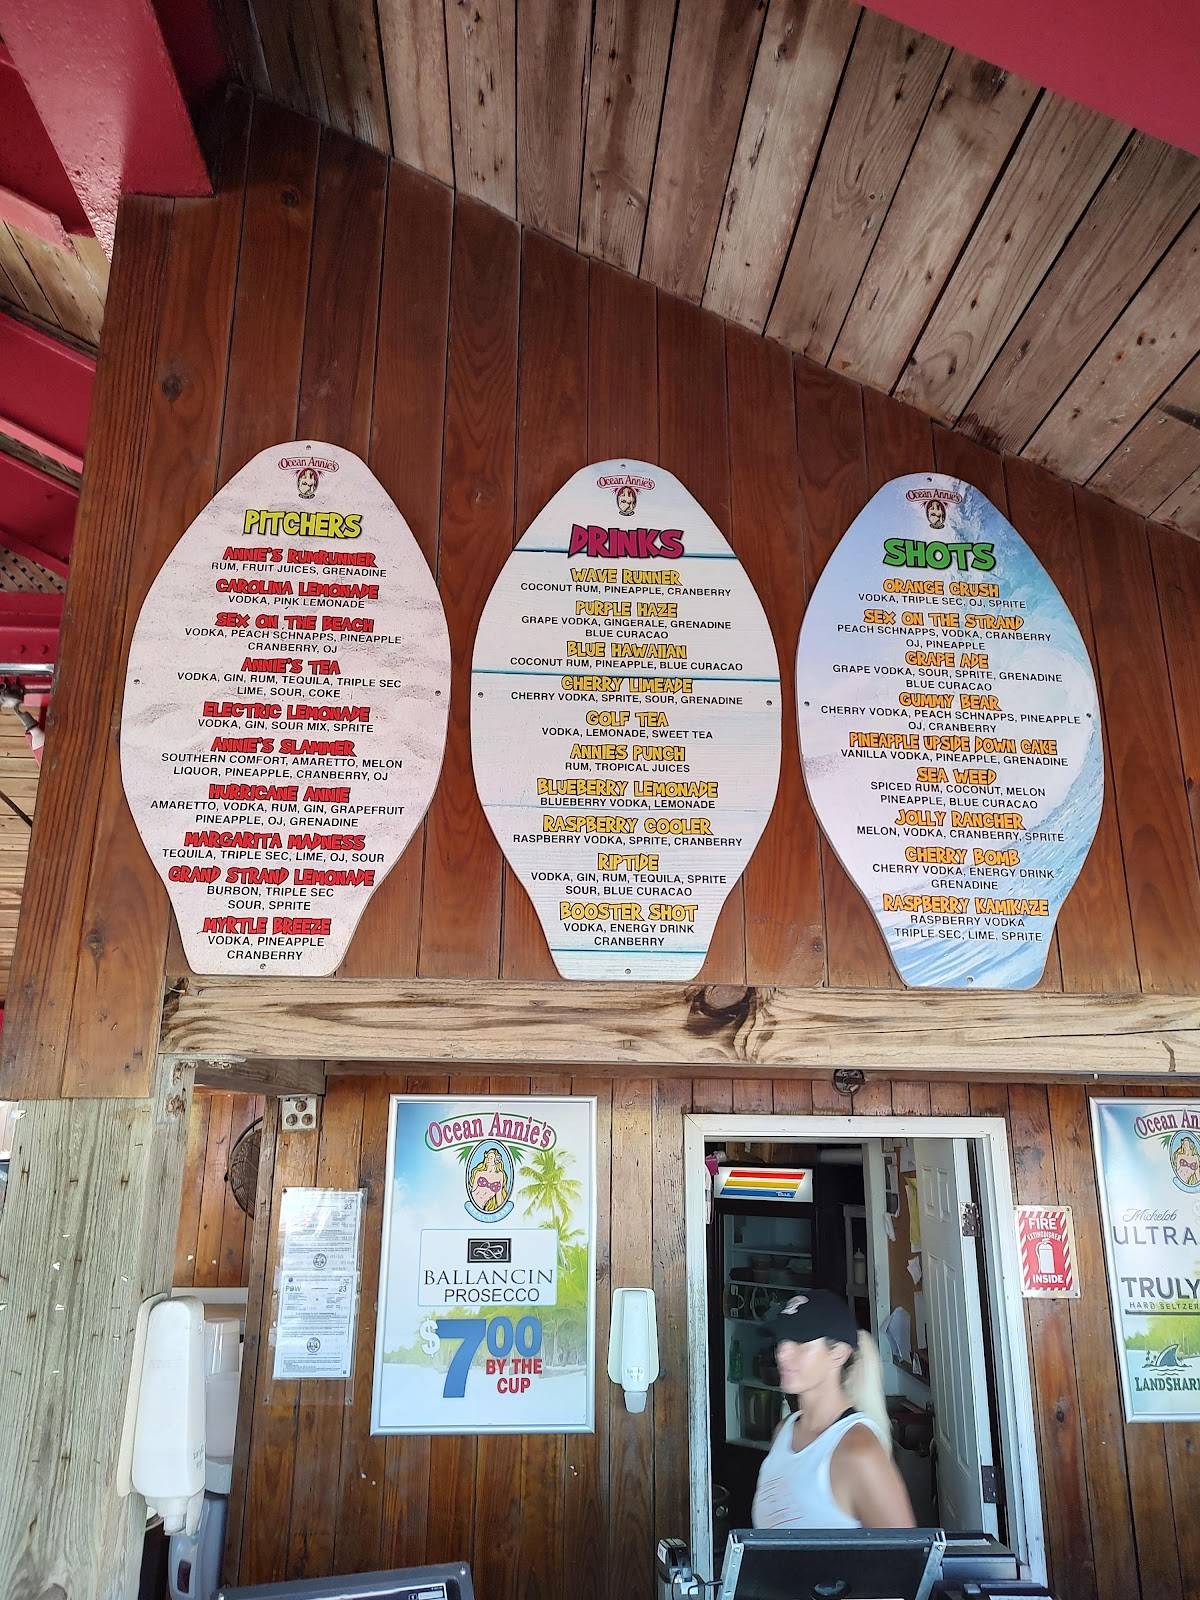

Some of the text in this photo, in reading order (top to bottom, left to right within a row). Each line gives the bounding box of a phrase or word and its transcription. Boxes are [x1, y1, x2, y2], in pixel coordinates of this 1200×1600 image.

[280, 457, 338, 472] Ocean Annie's
[599, 476, 653, 489] Ocean Annie's
[907, 488, 961, 503] Ocean Annie's
[243, 509, 362, 539] PITCHERS
[568, 524, 684, 559] DRINKS
[223, 546, 377, 568] ANNIE'S RUMRUNNER
[883, 537, 996, 571] SHOTS
[570, 568, 682, 586] WAVE RUNNER
[216, 578, 379, 599] CAROLINA LEMONADE
[883, 579, 999, 597] ORANGE CRUSH
[228, 595, 365, 609] VODKA, PINK LEMONADE
[575, 600, 678, 618] PURPLE HAZE
[216, 612, 374, 633] SEX ON THE BEACH
[864, 609, 1024, 631] SEX ON THE STRAND
[585, 629, 668, 639] BLUE CURACAO
[248, 642, 338, 654] CRANBERRY, OJ
[567, 641, 687, 659] BLUE HAWAIIAN
[906, 640, 985, 650] OJ, PINEAPPLE
[241, 657, 341, 675] ANNIE'S TEA
[905, 651, 989, 669] GRAPE ADE
[237, 687, 340, 698] LIME, SOUR, COKE
[561, 676, 693, 694] CHERRY LIMEADE
[906, 679, 992, 691] BLUE CURACAO
[511, 692, 743, 705] CHERRY VODKA, SPRITE, SOUR, GRENADINE
[899, 692, 1002, 711] GUMMY BEAR
[203, 701, 370, 722] ELECTRIC LEMONADE
[586, 711, 668, 727] GOLF TEA
[908, 721, 996, 733] OJ, CRANBERRY
[211, 737, 357, 757] ANNIE'S SLAMMER
[570, 744, 686, 761] ANNIES PUNCH
[849, 732, 1057, 755] PINEAPPLE UPSIDE DOWN CAKE
[161, 753, 402, 768] SOUTHERN COMFORT, AMARETTO, MELON
[841, 749, 1068, 766] VANILLA VODKA, PINEAPPLE, GRENADINE
[565, 763, 690, 773] RUM, TROPICAL JUICES
[916, 767, 997, 785] SEA WEED
[209, 784, 351, 803] HURRICANE ANNIE
[537, 778, 718, 798] BLUEBERRY LEMONADE
[881, 795, 1038, 808] PINEAPPLE, BLUE CURACAO
[196, 815, 358, 827] PINEAPPLE, OJ, GRENADINE
[543, 815, 713, 836] RASPBERRY COOLER
[895, 809, 1026, 830] JOLLY RANCHER
[184, 831, 365, 851] MARGARITA MADNESS
[597, 853, 659, 871] RIPTIDE
[905, 847, 1020, 866] CHERRY BOMB
[169, 866, 375, 886] GRAND STRAND LEMONADE
[931, 879, 998, 889] GRENADINE
[207, 886, 334, 897] BURBON, TRIPLE SEC
[566, 886, 692, 896] SOUR, BLUE CURACAO
[228, 900, 311, 911] SOUR, SPRITE
[560, 902, 698, 922] BOOSTER SHOT
[883, 894, 1049, 916] RASPBERRY KAMIKAZE
[202, 917, 331, 935] MYRTLE BREEZE
[564, 923, 694, 934] VODKA, ENERGY DRINK
[910, 915, 1025, 926] RASPBERRY VODKA
[208, 936, 325, 946] VODKA, PINEAPPLE
[594, 937, 664, 946] CRANBERRY
[427, 1112, 552, 1149] Ocean Annie's
[1136, 1113, 1178, 1136] Ocean
[1029, 1218, 1057, 1229] FIRE
[1123, 1209, 1177, 1222] Michelob
[1113, 1226, 1198, 1245] ULTRA
[424, 1268, 553, 1285] BALLANCIN
[1033, 1275, 1063, 1283] INSIDE
[444, 1288, 539, 1302] PROSECCO
[1121, 1277, 1200, 1299] TRULY
[486, 1359, 542, 1374] BY THE
[497, 1378, 531, 1394] CUP
